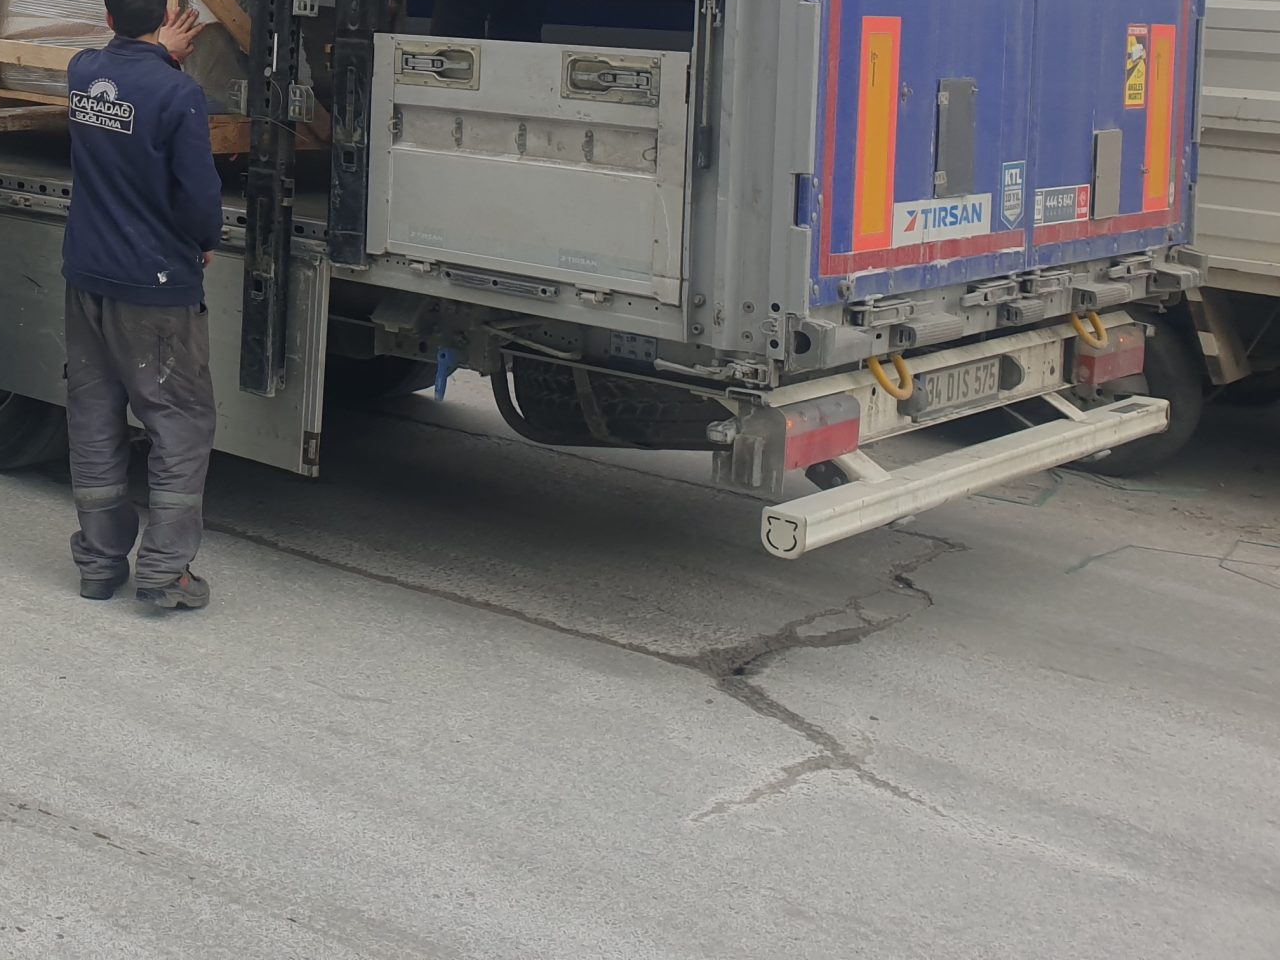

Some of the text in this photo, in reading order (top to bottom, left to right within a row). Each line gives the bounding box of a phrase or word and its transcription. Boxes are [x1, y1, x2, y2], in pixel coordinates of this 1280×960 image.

[72, 94, 130, 118] KARADAĞ
[75, 111, 121, 129] SOĞUTMA
[1005, 168, 1023, 185] KTL
[920, 202, 982, 230] TIRSAN
[927, 361, 996, 407] 34 DIS 575
